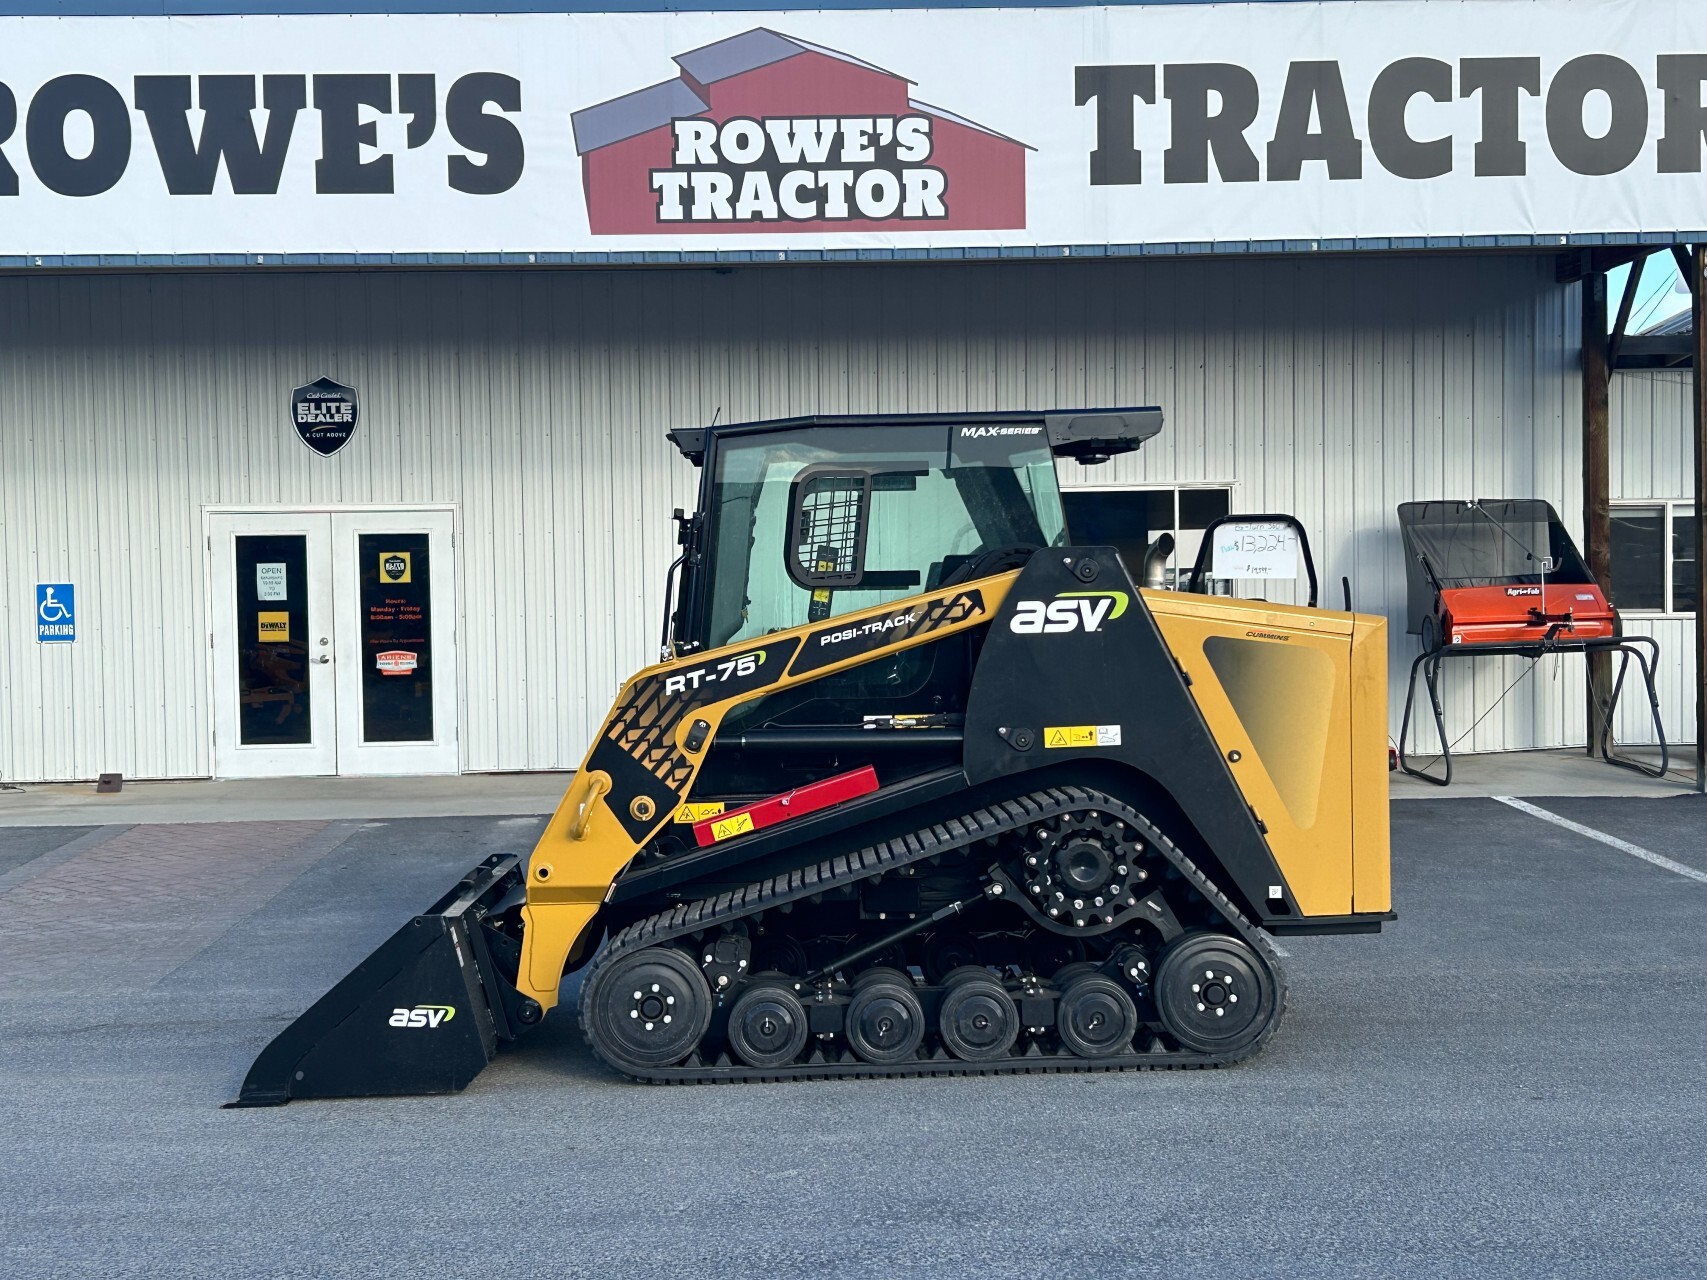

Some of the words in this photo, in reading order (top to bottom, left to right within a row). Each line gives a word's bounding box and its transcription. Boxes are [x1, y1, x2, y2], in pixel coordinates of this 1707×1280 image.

[0, 72, 525, 197] OWE'S
[673, 116, 932, 166] ROWE'S
[651, 167, 946, 221] TRACTOR
[297, 402, 353, 414] ELITE
[297, 413, 353, 423] DEALER
[39, 624, 74, 636] PARKING
[820, 612, 916, 647] POSI-TRACK
[665, 655, 757, 696] RT-75
